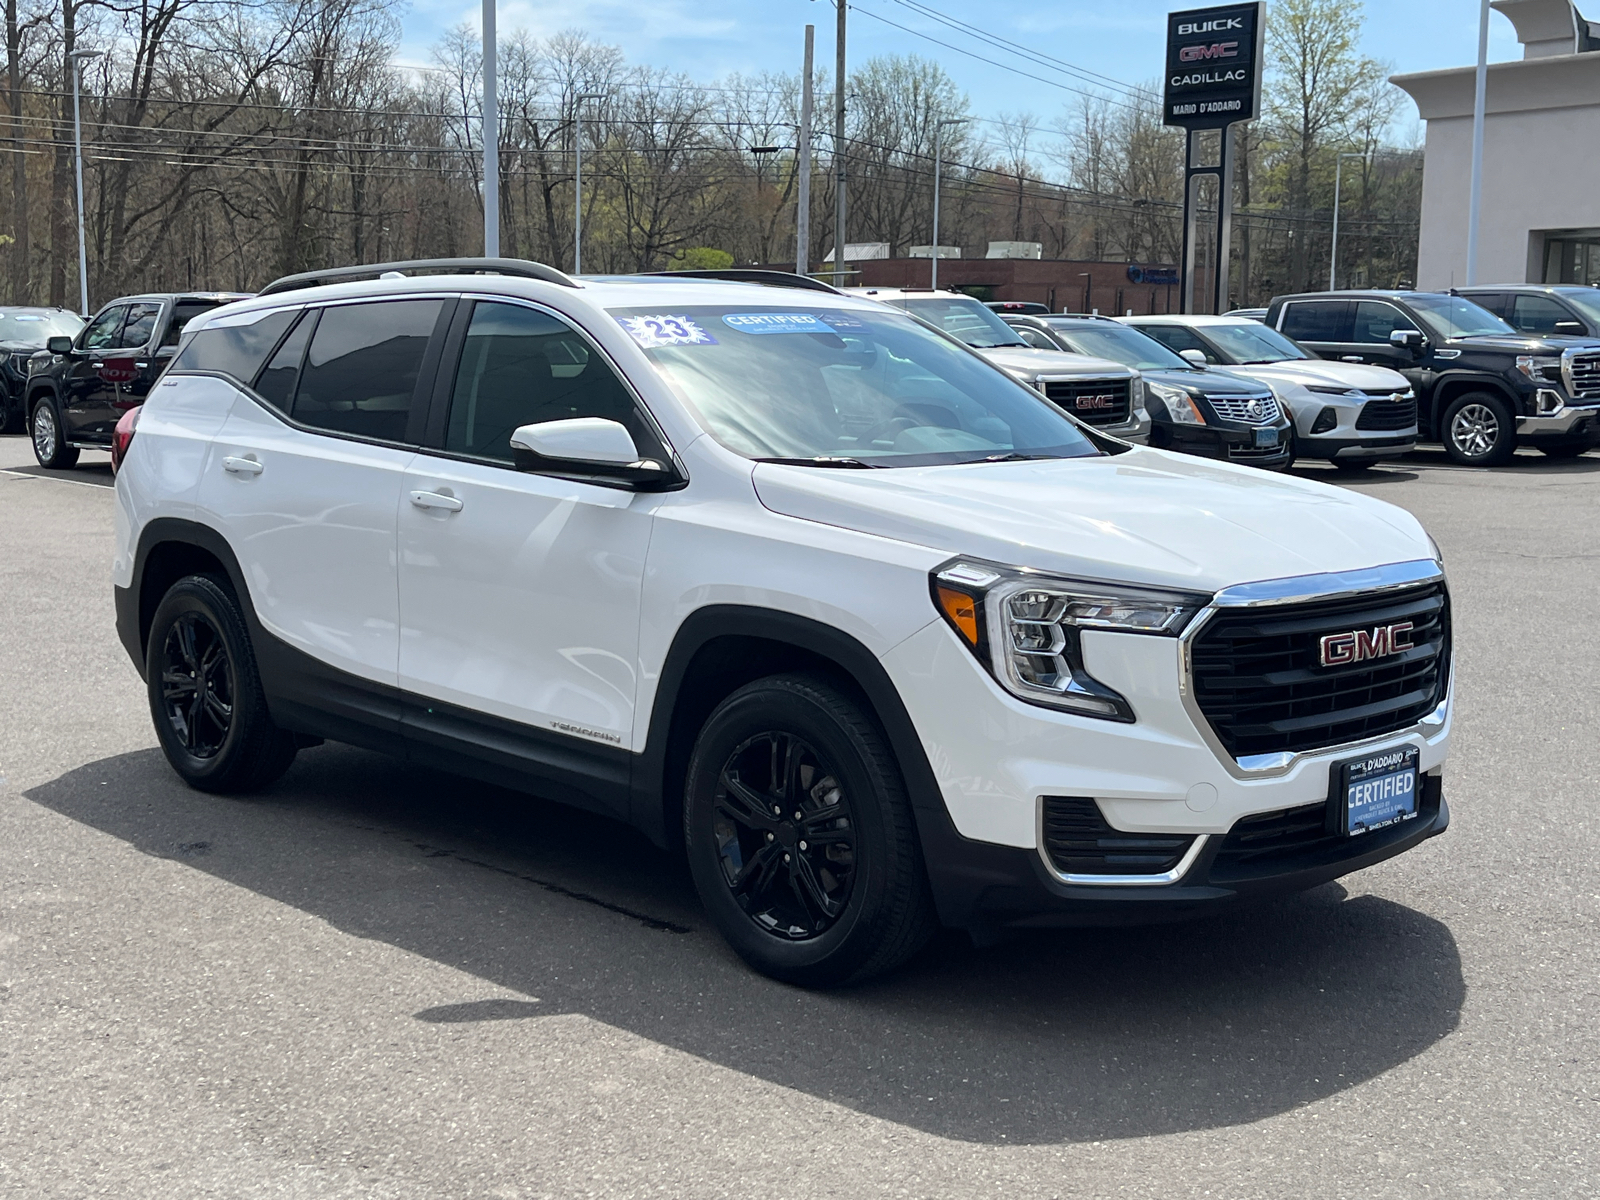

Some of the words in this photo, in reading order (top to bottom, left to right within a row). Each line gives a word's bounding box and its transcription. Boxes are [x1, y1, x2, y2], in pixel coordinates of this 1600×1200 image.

[1178, 17, 1243, 35] BUICK
[1179, 41, 1239, 62] GMC
[1171, 69, 1246, 86] CADILLAC
[1173, 104, 1196, 114] MARIO
[1200, 100, 1241, 113] D'ADDARIO
[644, 319, 690, 339] 23
[726, 314, 818, 326] CERTIFIED
[1076, 394, 1114, 410] GMC
[1320, 621, 1414, 667] GMC
[1367, 752, 1404, 771] D'ADDARIO
[1348, 772, 1414, 809] CERTIFIED
